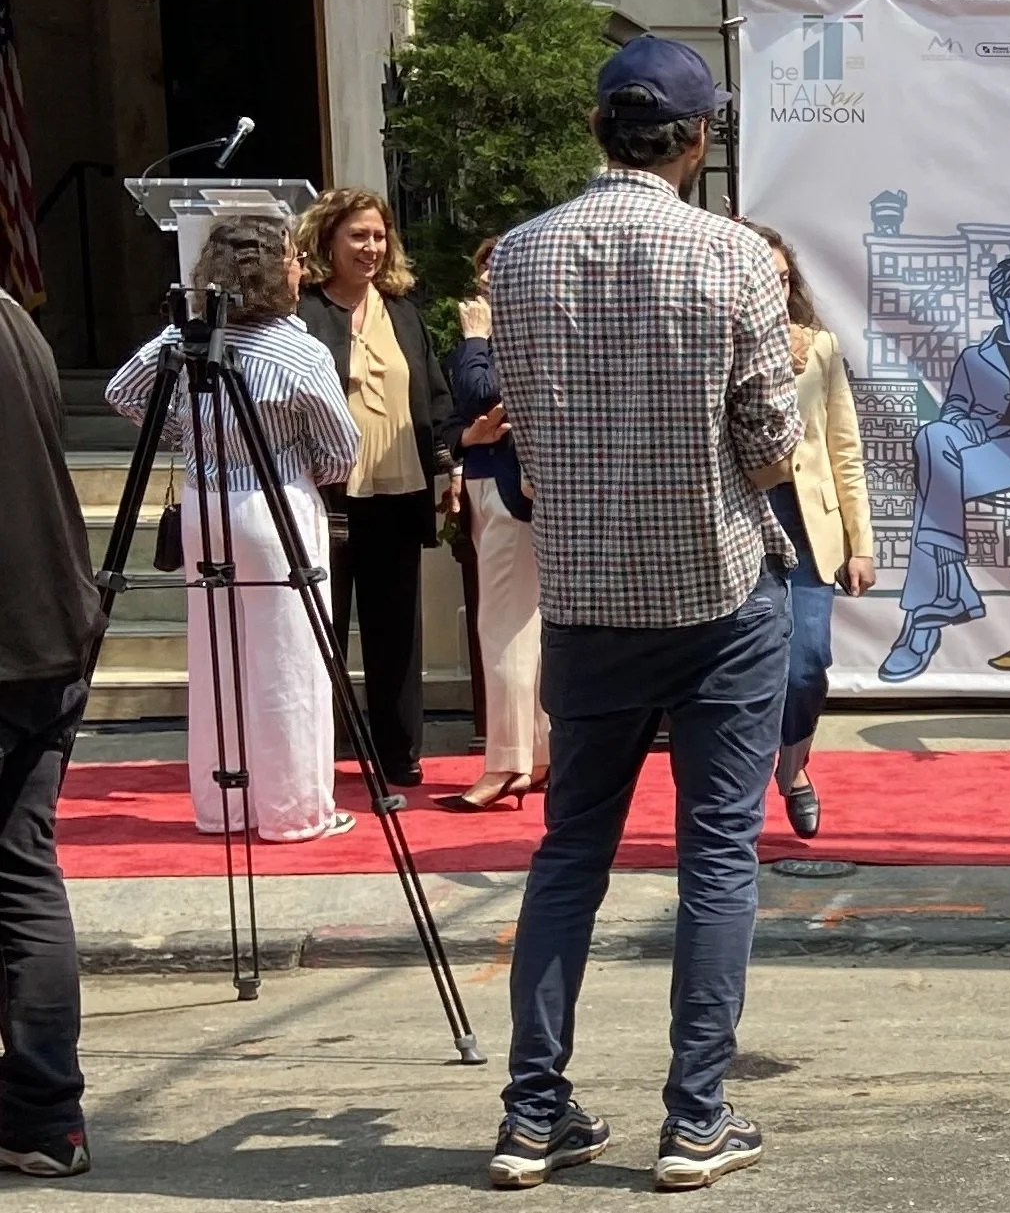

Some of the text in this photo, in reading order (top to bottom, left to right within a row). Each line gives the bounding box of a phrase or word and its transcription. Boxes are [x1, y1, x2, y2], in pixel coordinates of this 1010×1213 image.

[770, 60, 799, 81] be
[770, 83, 843, 108] ITALY
[770, 107, 865, 124] MADISON
